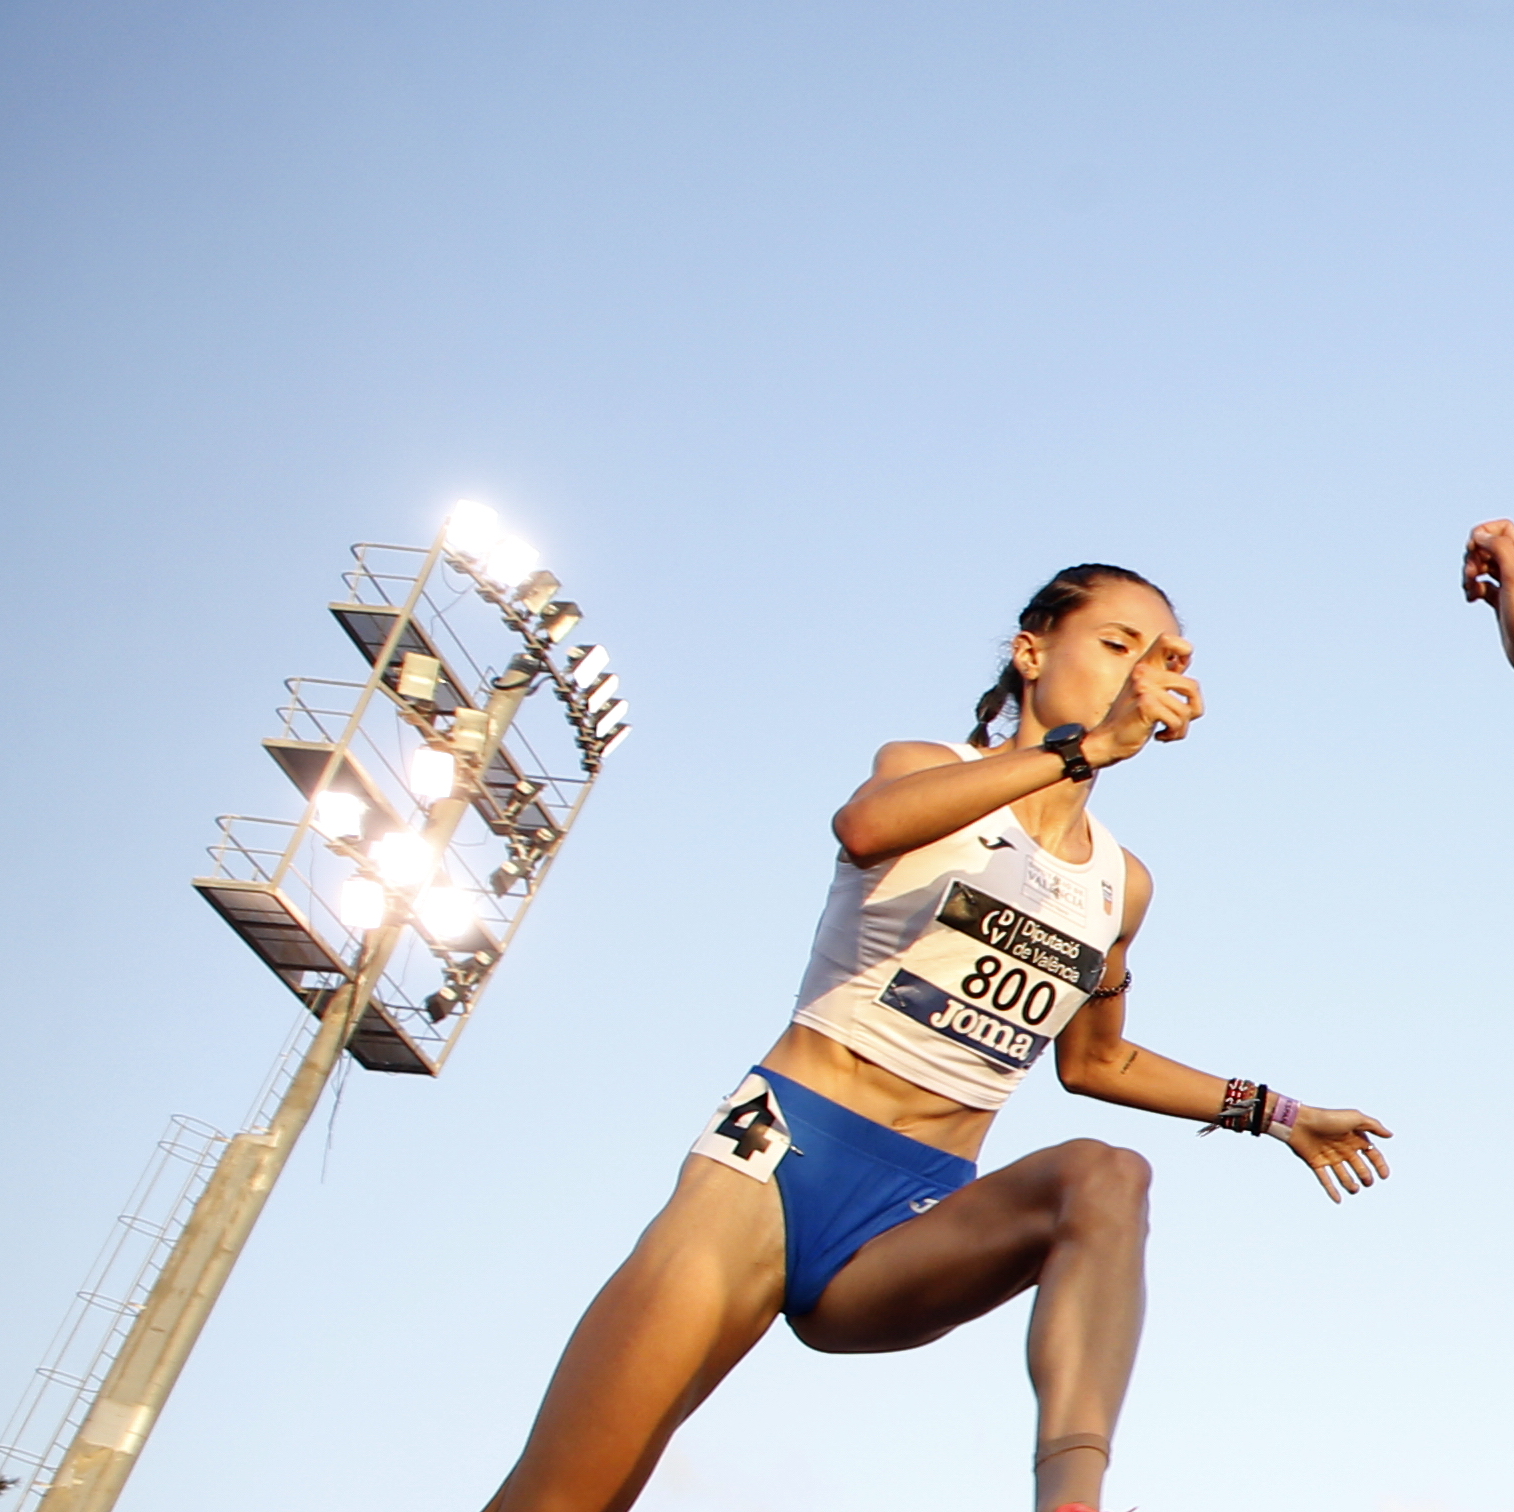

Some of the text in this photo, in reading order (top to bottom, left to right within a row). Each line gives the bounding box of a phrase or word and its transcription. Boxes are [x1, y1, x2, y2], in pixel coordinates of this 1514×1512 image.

[1012, 941, 1080, 984] de València
[1021, 920, 1080, 959] Diputació
[961, 955, 1056, 1026] 800
[929, 998, 1034, 1061] Joma
[714, 1090, 775, 1161] 4
